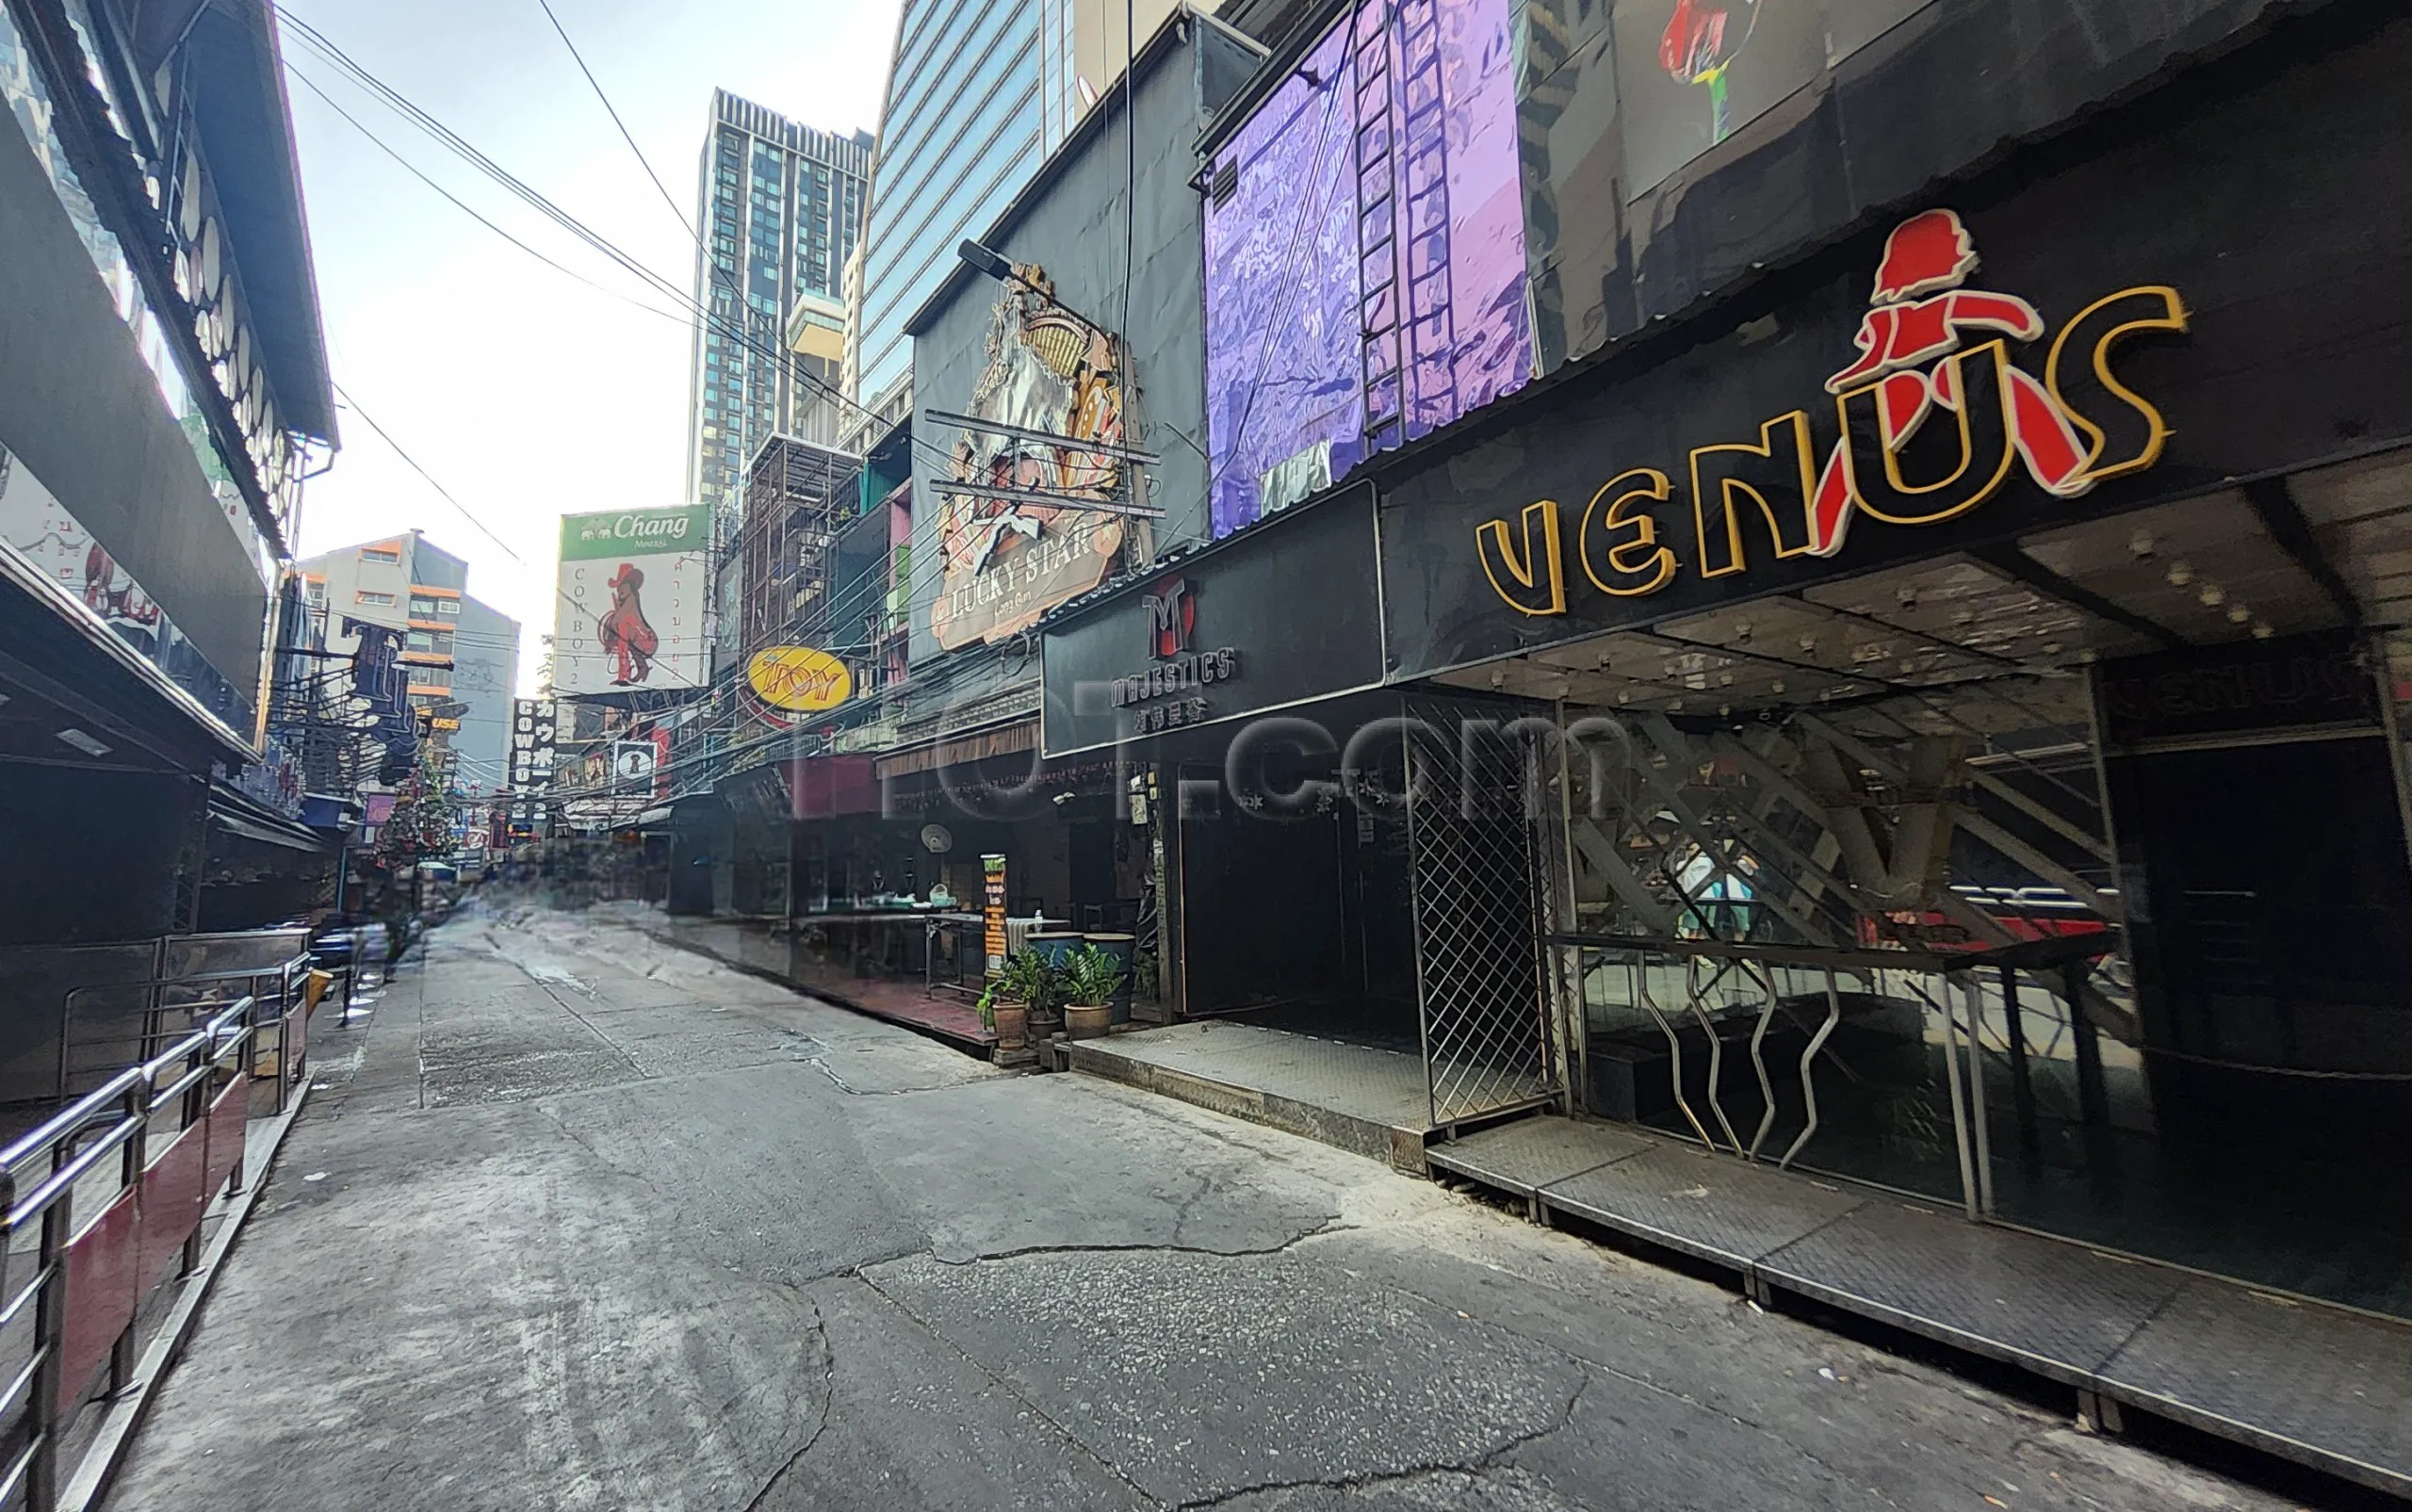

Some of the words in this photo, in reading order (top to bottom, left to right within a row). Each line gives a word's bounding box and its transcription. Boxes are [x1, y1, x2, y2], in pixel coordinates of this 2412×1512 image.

[1475, 285, 2191, 616] VENUS
[614, 514, 689, 539] Chang
[951, 557, 1020, 620] LUCKY
[1025, 522, 1091, 583] STAR
[761, 660, 844, 702] TOY
[1111, 646, 1236, 707] MAJESTICS
